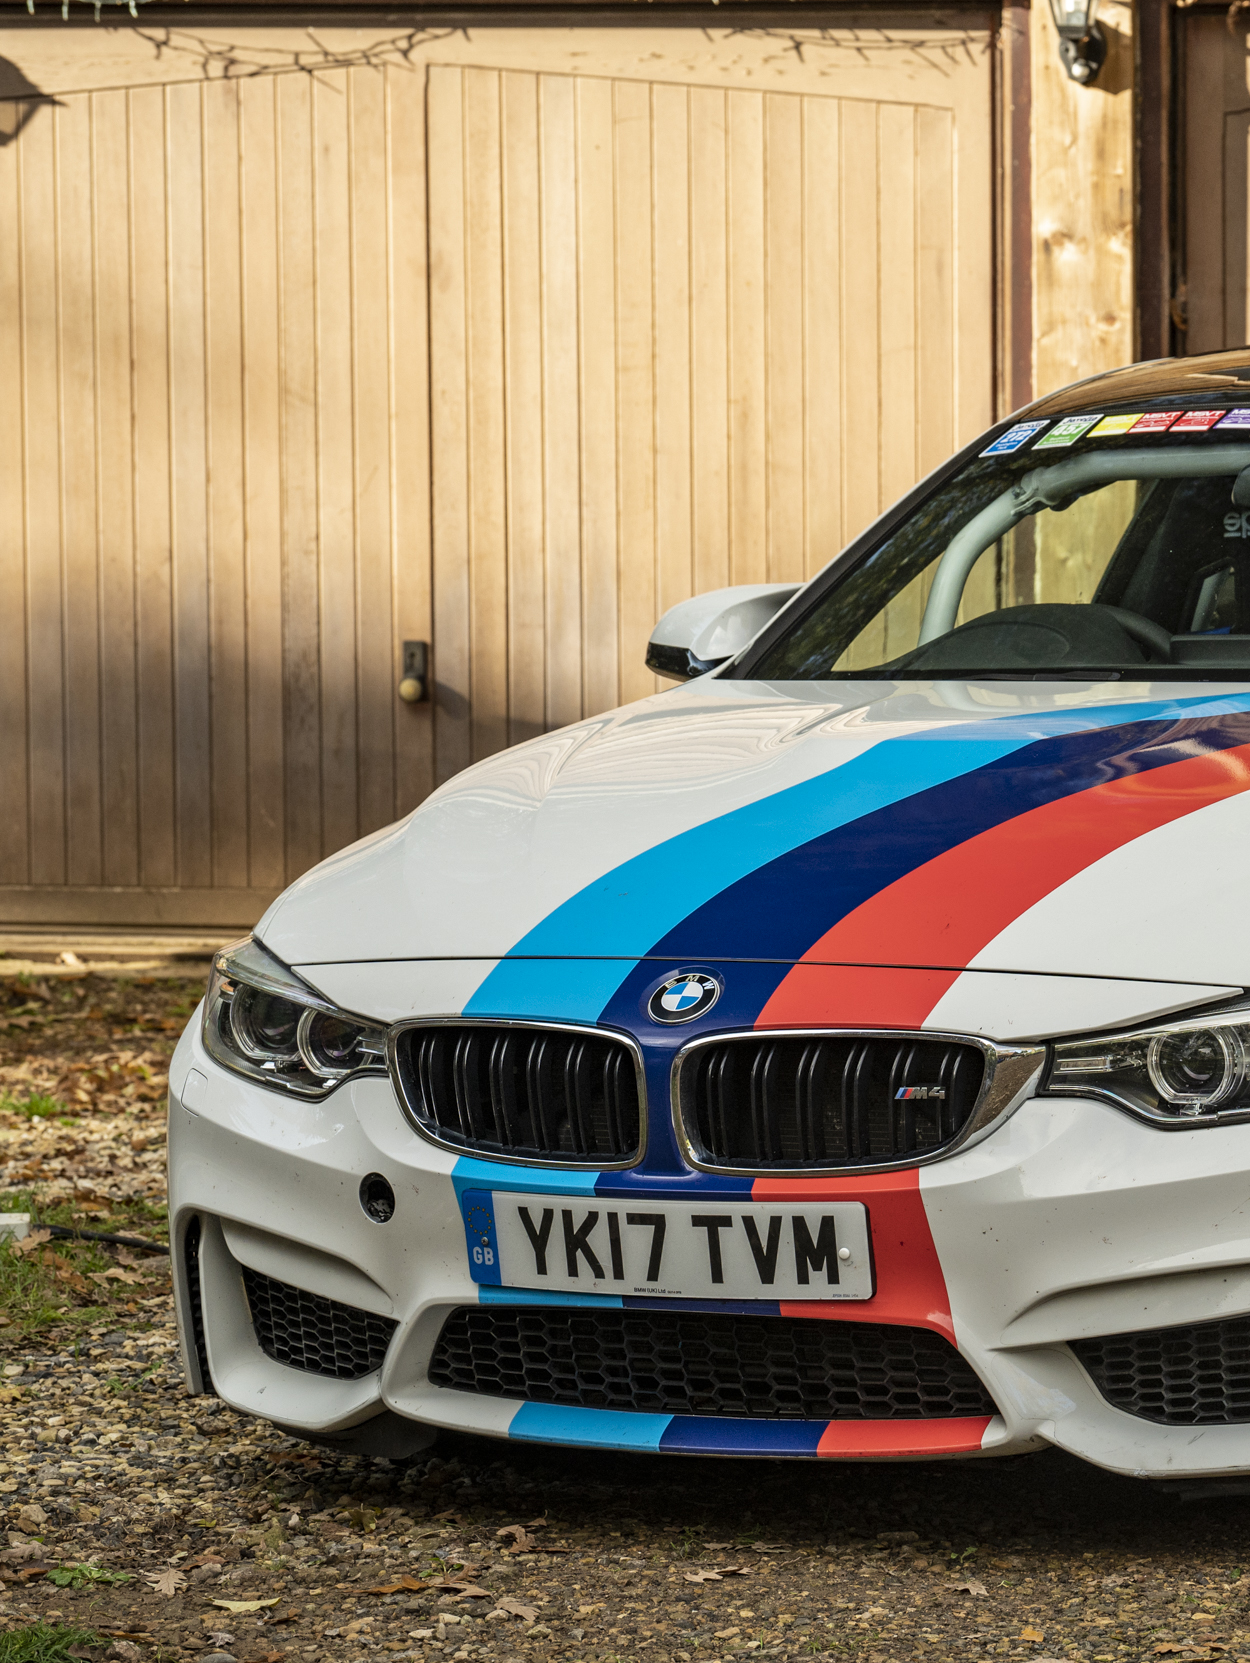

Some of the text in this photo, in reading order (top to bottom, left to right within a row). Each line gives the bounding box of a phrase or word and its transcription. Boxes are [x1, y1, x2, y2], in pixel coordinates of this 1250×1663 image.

[1142, 411, 1181, 419] MSVT
[1051, 422, 1086, 436] 457
[1000, 430, 1033, 444] 272
[664, 975, 715, 990] BMW
[517, 1206, 840, 1285] YK17 TVM
[472, 1246, 495, 1266] GB
